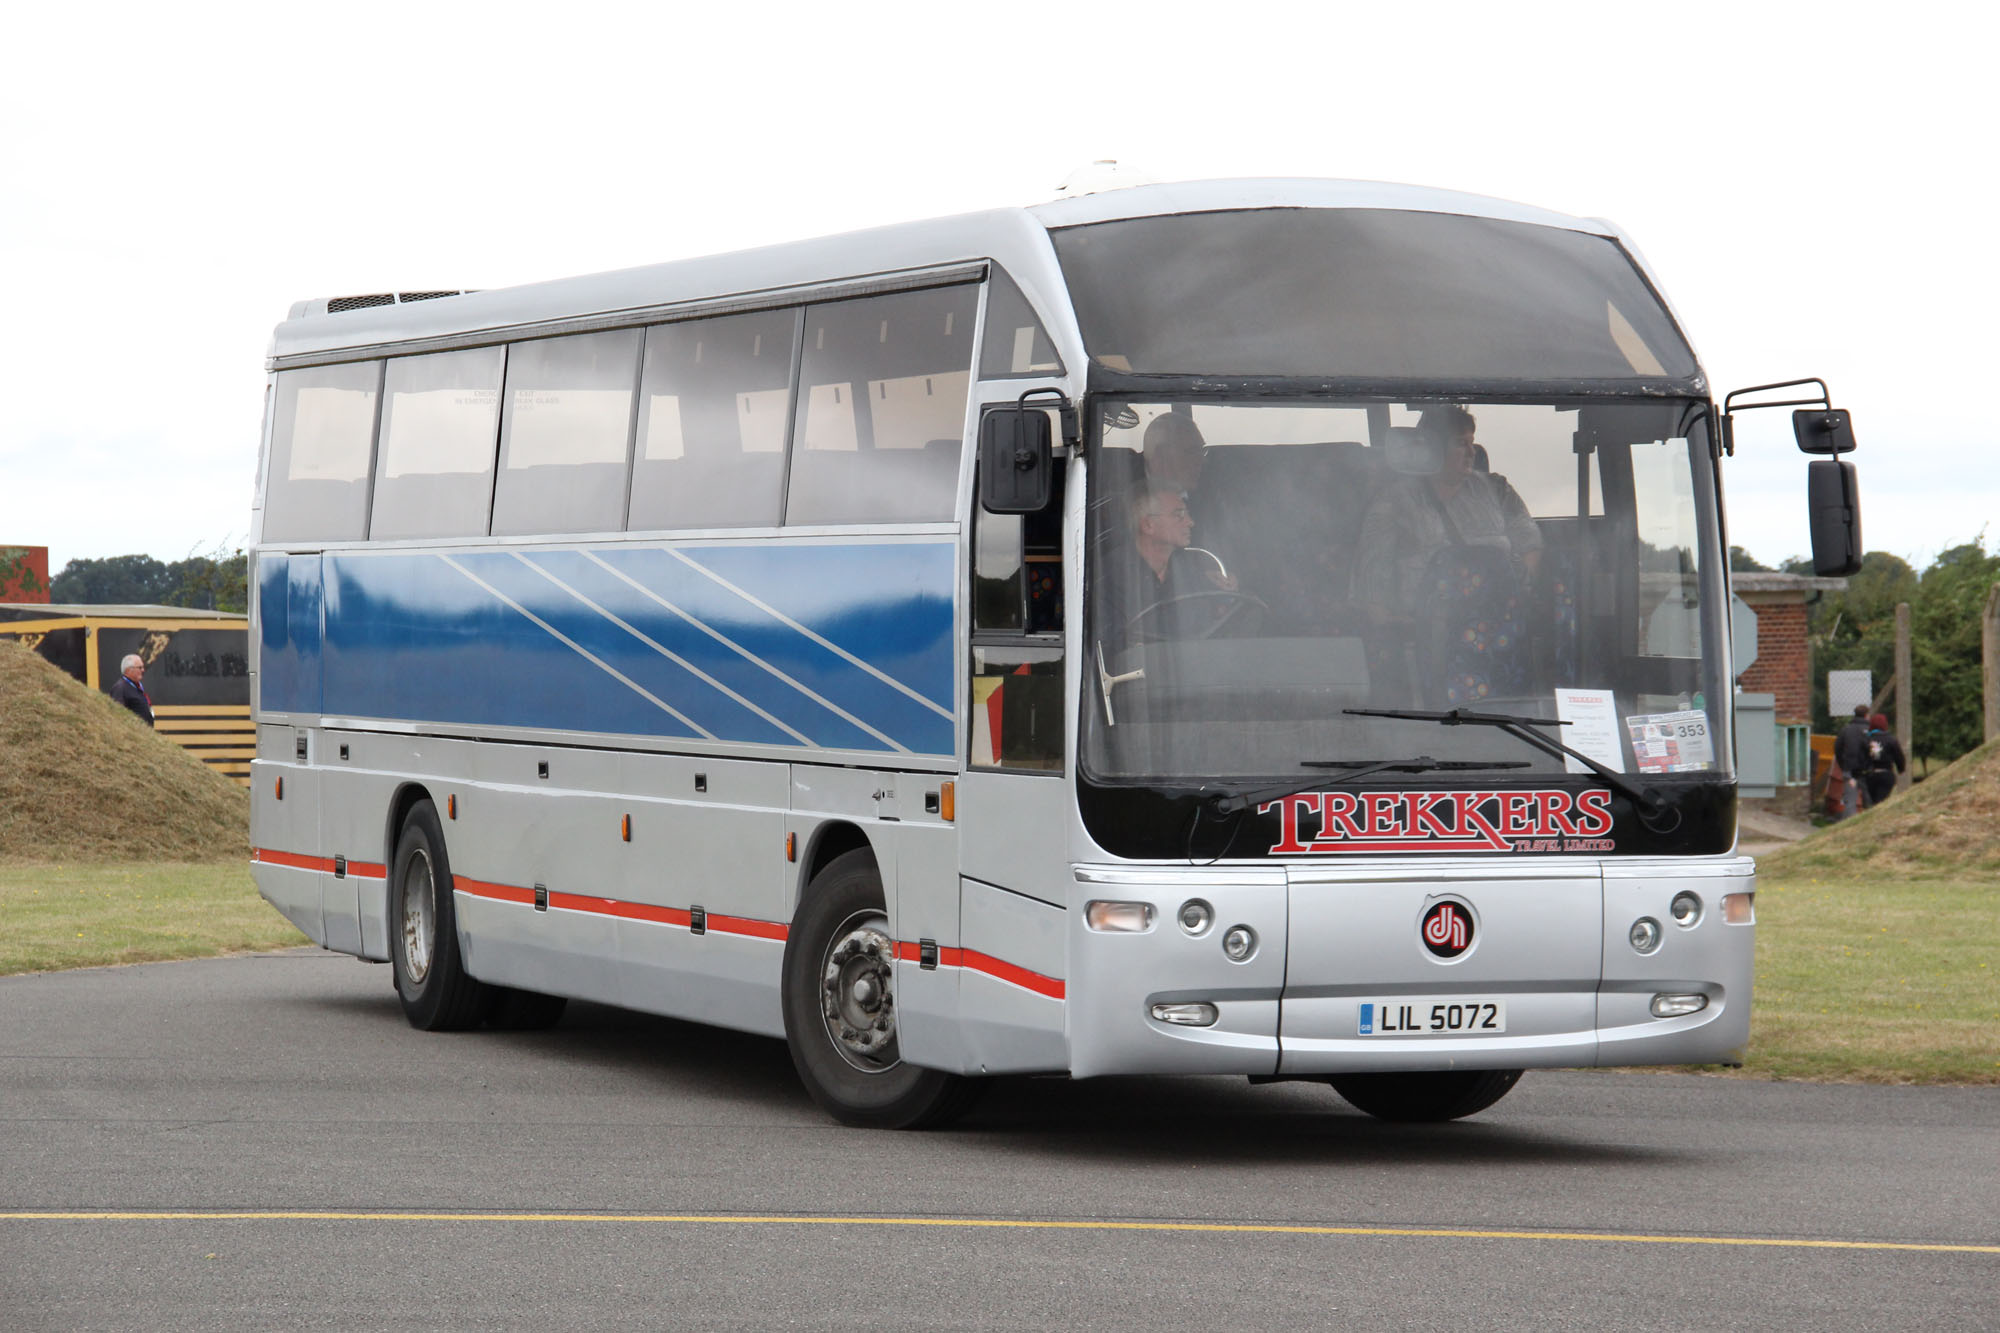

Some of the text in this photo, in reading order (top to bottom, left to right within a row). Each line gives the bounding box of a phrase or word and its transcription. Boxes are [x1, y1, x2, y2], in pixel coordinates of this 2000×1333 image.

[1678, 724, 1705, 737] 353
[1257, 789, 1614, 855] TREKKERS
[1515, 838, 1615, 852] TRAVEL LIMITED
[1381, 1004, 1497, 1031] LIL 5072
